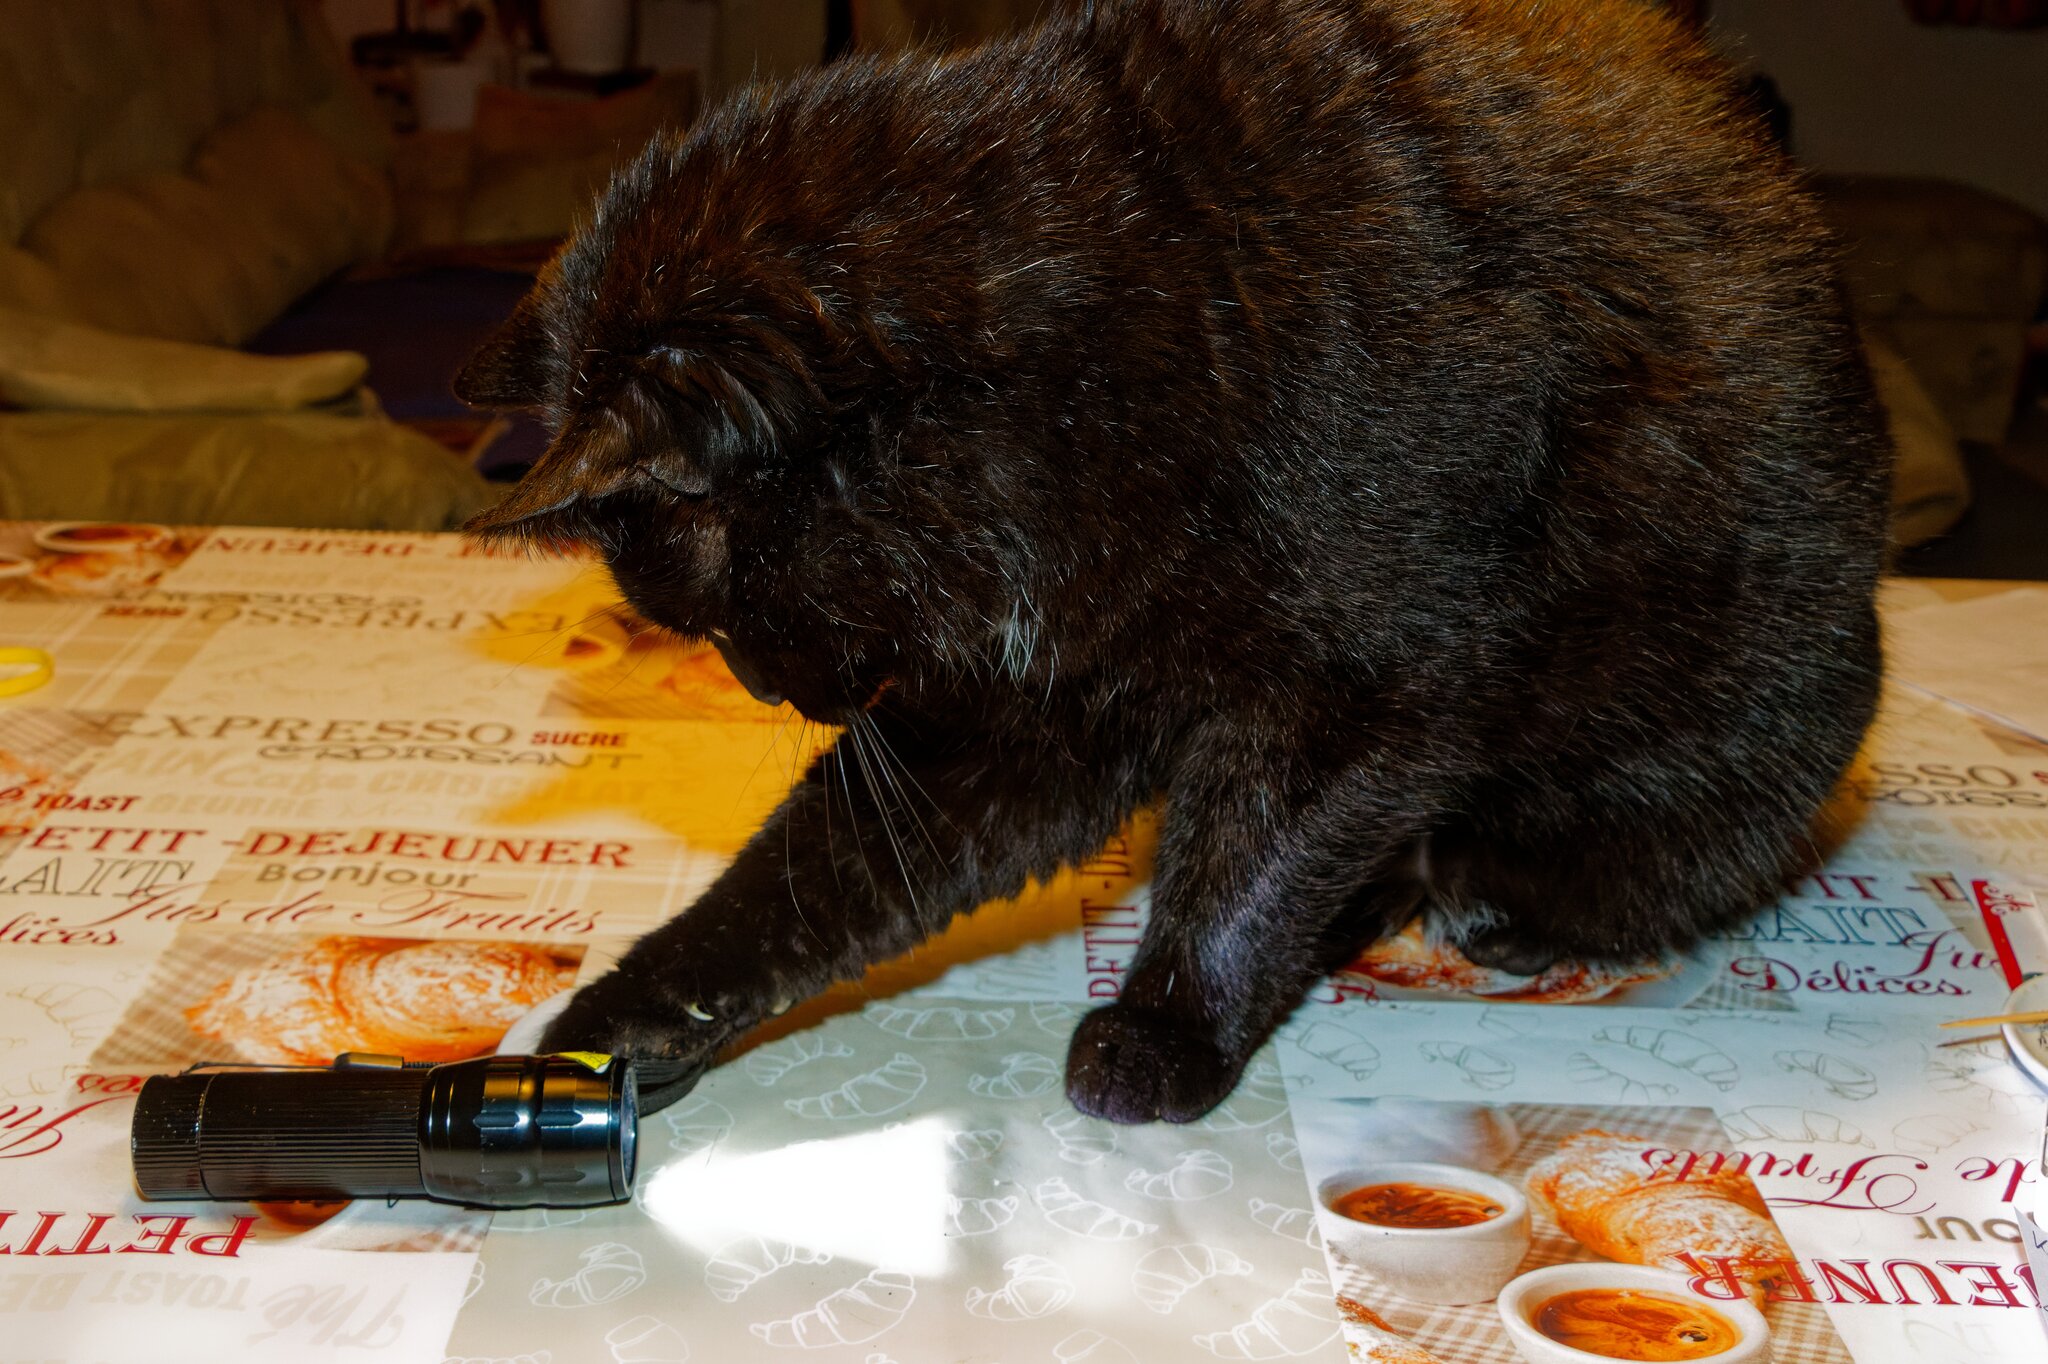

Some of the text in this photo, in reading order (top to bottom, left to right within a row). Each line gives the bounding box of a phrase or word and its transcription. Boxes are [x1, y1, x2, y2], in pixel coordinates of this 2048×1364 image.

[93, 711, 515, 746] EXPRESSO
[530, 731, 629, 747] SUCRE
[258, 744, 643, 769] CROISSANT
[1867, 761, 2018, 788] SSO
[32, 793, 142, 812] TOAST
[0, 857, 195, 898] AIT
[255, 862, 479, 888] Bonjour
[243, 890, 335, 925] de
[352, 887, 603, 932] Fruits
[0, 912, 122, 948] lices
[1730, 956, 1973, 996] Délices
[1640, 1149, 2037, 1215] de Fruits
[0, 1208, 260, 1258] PETI
[88, 1270, 252, 1312] TOAST
